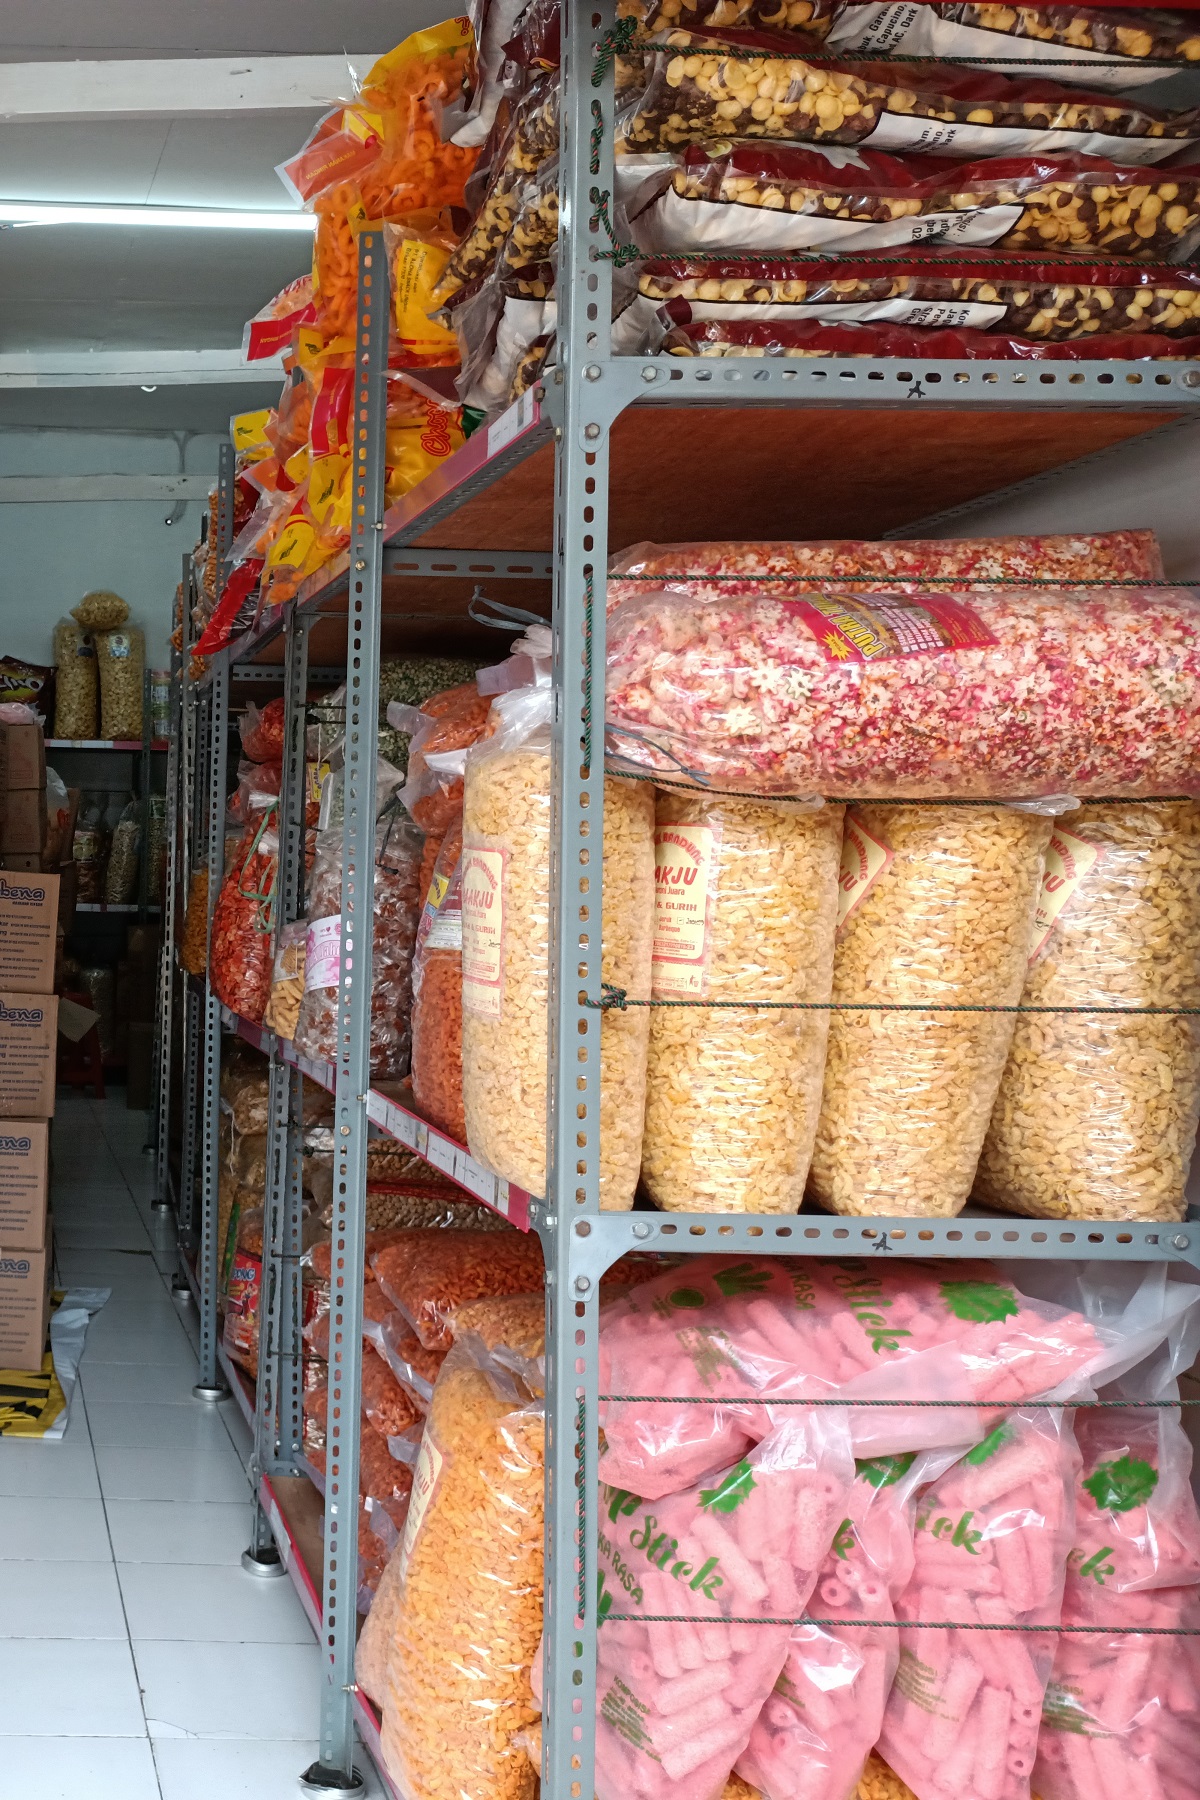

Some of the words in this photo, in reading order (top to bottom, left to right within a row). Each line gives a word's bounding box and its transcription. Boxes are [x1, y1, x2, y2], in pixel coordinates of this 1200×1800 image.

[900, 8, 918, 28] Dark
[828, 613, 887, 661] PUTRA
[665, 901, 697, 912] GURIH
[612, 1554, 643, 1605] RASA
[629, 1515, 724, 1601] Stick
